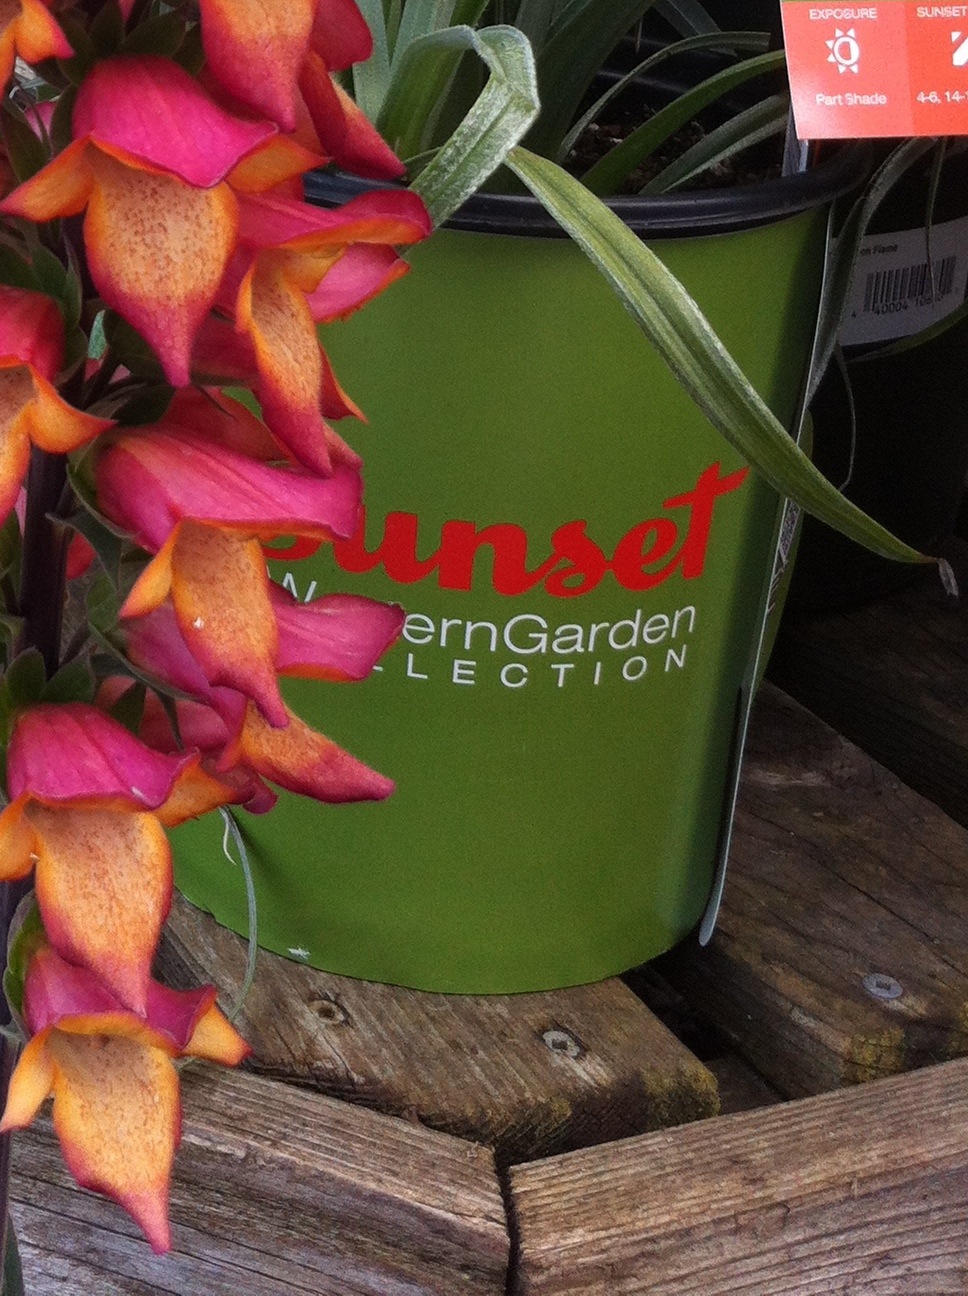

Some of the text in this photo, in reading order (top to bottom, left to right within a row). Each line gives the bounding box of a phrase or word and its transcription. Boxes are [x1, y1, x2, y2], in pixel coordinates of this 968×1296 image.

[809, 7, 878, 20] EXPOSURE
[916, 5, 968, 18] SUNSET
[816, 92, 888, 105] Part Shade
